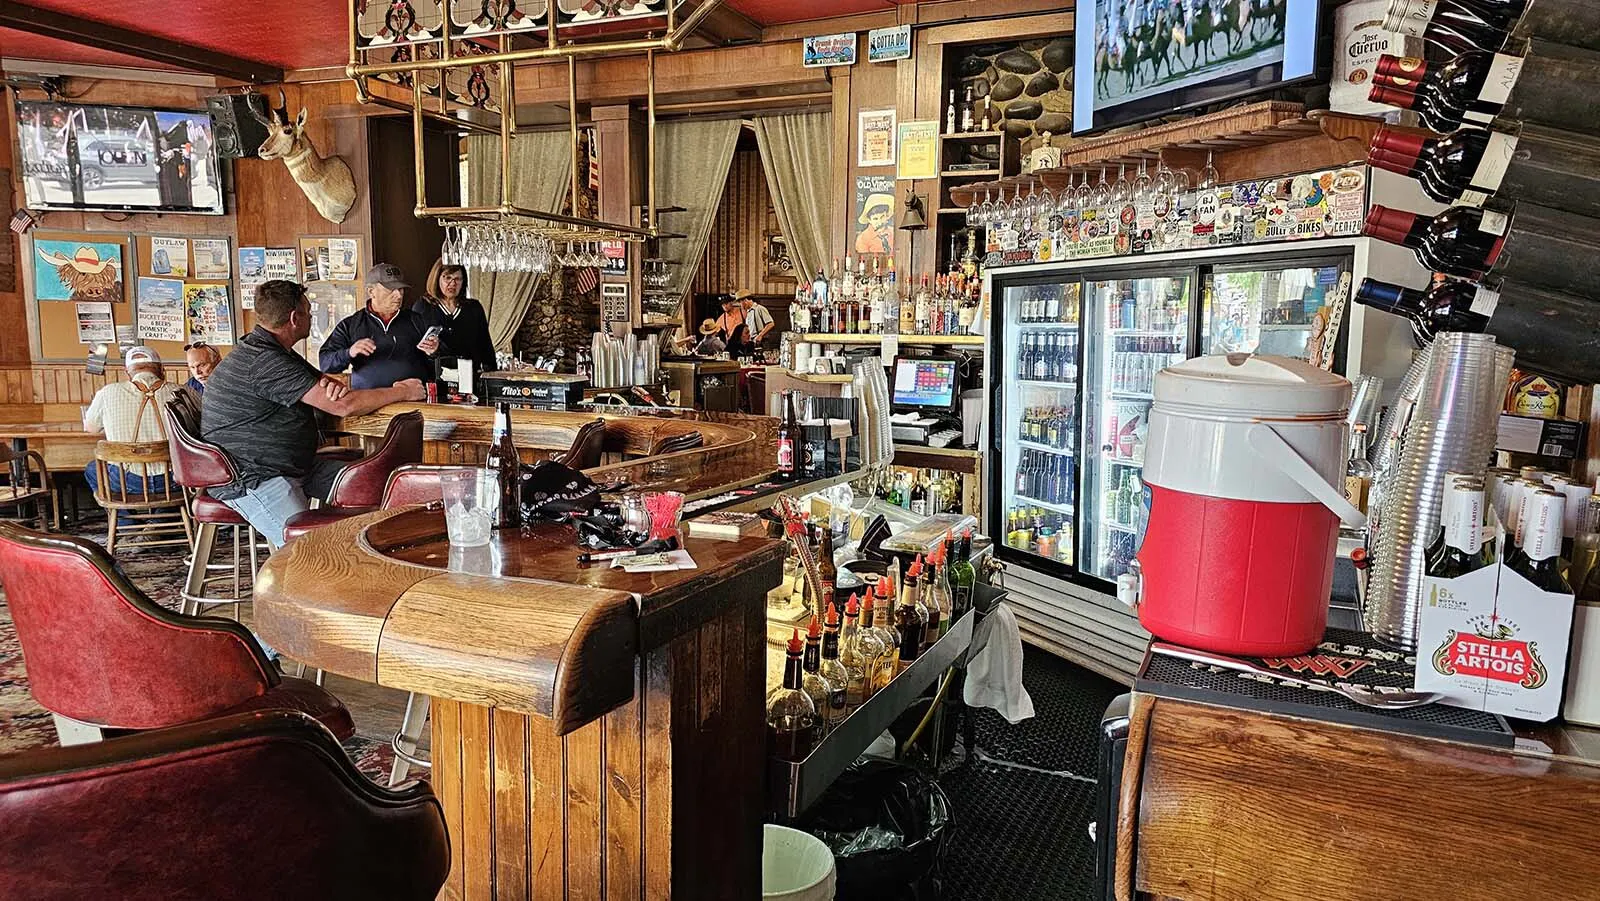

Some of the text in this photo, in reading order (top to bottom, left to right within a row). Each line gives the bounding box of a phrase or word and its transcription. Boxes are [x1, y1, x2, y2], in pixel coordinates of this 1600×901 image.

[876, 34, 895, 49] GOTTA
[1349, 40, 1388, 58] Cuervo
[1352, 57, 1377, 66] ESPECI
[1202, 195, 1213, 205] BJ
[1199, 205, 1216, 214] FAN
[1297, 222, 1321, 234] BIKES
[139, 325, 168, 333] DOMESTIC
[501, 386, 522, 396] Tito's
[1457, 641, 1525, 663] STELLA
[1454, 655, 1525, 675] ARTOIS
